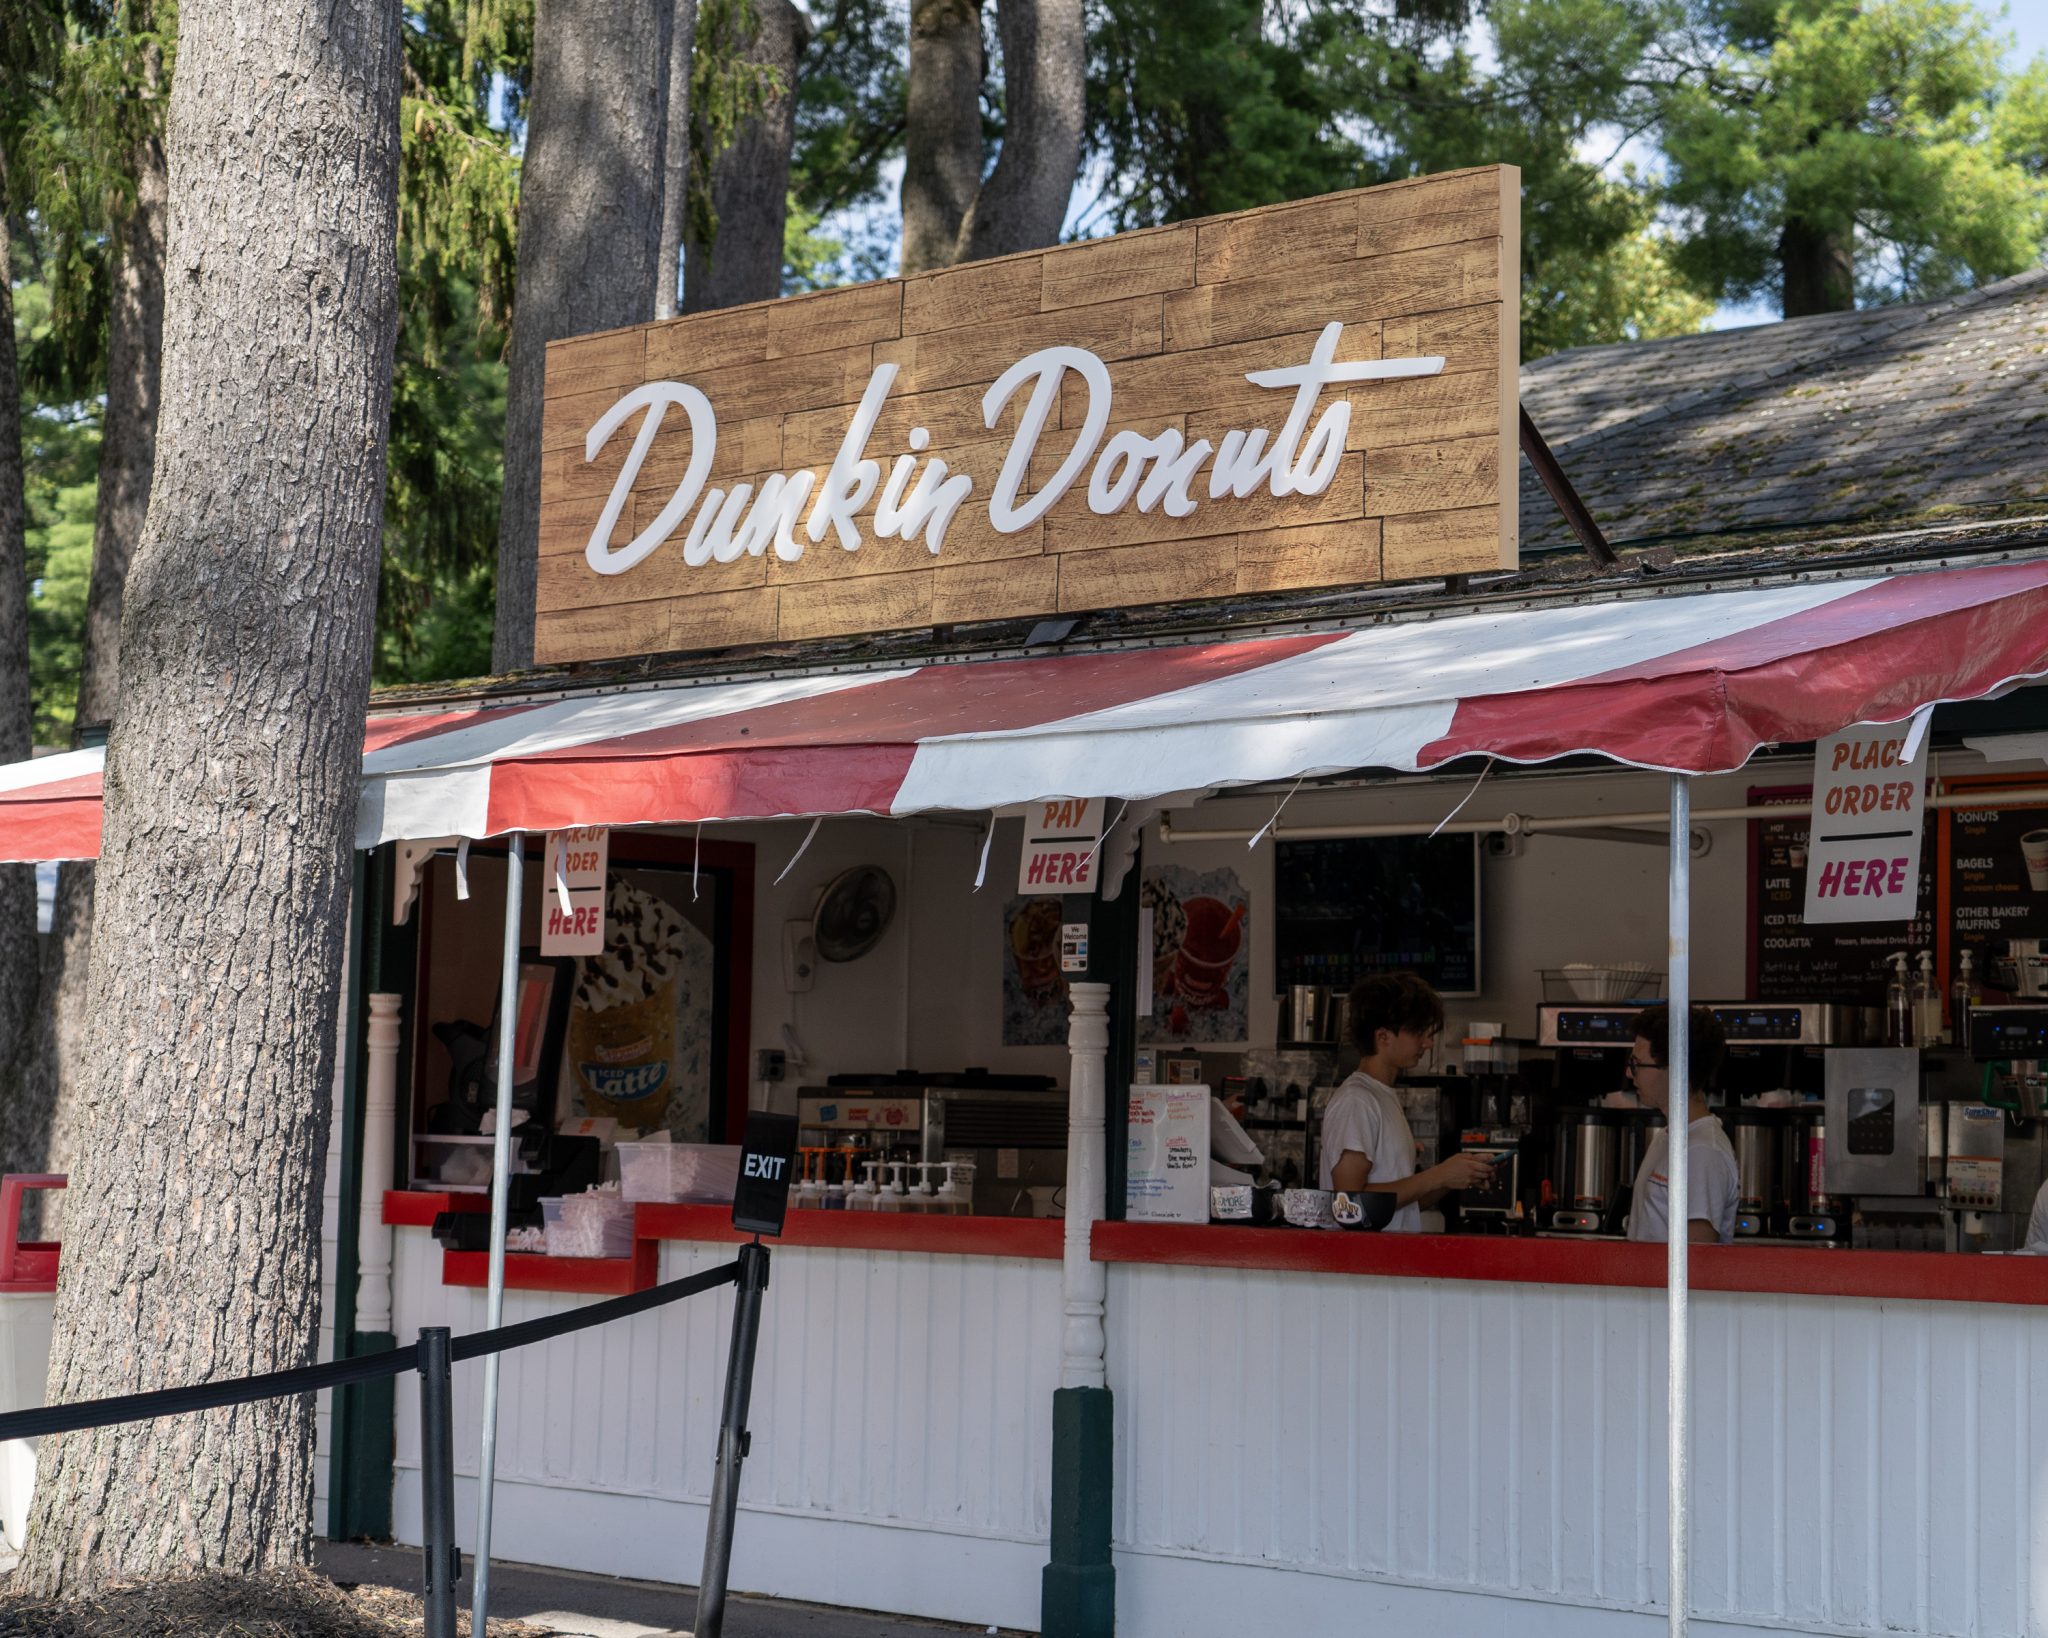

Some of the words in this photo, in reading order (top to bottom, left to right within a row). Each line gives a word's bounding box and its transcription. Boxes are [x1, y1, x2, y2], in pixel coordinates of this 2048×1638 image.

[584, 363, 973, 576] Dunkin
[981, 321, 1446, 534] Donuts
[1825, 780, 1914, 816] ORDER
[1042, 799, 1088, 829] PAY
[1957, 811, 1999, 823] DONUTS
[550, 827, 605, 844] PCK-UP
[1027, 852, 1092, 885] HERE
[1956, 857, 1994, 869] BAGELS
[1765, 878, 1790, 889] LATTE
[1817, 857, 1909, 898] HERE
[1770, 891, 1792, 901] ICED
[1763, 914, 1785, 925] ICED
[1786, 913, 1804, 924] TEA
[1956, 906, 1989, 918] OTHER
[1992, 906, 2030, 917] BAKERY
[548, 907, 599, 936] HERE
[1955, 919, 2001, 930] MUFFINS
[588, 1061, 663, 1096] Latte
[599, 1069, 625, 1078] ICED
[744, 1153, 786, 1180] EXIT
